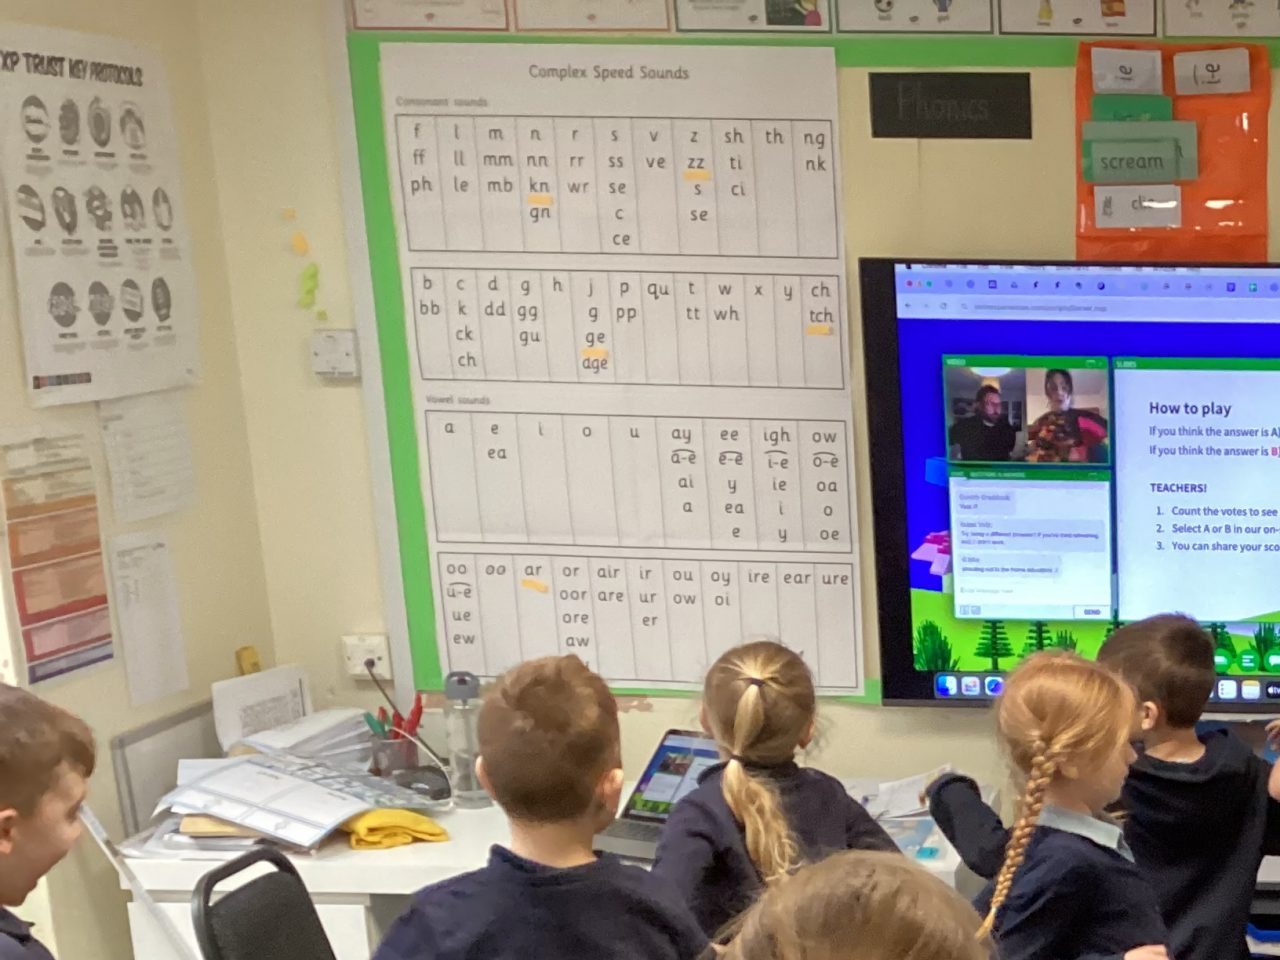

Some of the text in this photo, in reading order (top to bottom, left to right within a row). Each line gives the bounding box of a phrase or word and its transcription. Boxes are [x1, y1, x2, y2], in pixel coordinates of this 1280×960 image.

[22, 52, 65, 77] TRUST
[69, 58, 88, 80] KEY
[90, 61, 143, 87] PROTOCOLS
[529, 64, 690, 82] Complex Speed Sounds
[413, 149, 826, 171] ff ll mm nn rr ss ve zz ti nk
[1101, 156, 1164, 169] scream
[420, 300, 834, 323] bb k dd gg g pp tt wh tch
[1150, 402, 1231, 418] How to play
[445, 423, 455, 434] a
[491, 424, 499, 435] e
[582, 426, 592, 437] o
[630, 428, 640, 438] u
[671, 429, 691, 444] ay
[720, 430, 739, 441] ee
[764, 426, 791, 446] igh
[812, 432, 837, 443] ow
[1149, 426, 1156, 436] If
[1157, 428, 1176, 438] you
[1178, 426, 1204, 436] think
[1205, 426, 1222, 436] the
[1224, 429, 1259, 437] answer
[1261, 428, 1269, 437] is
[1271, 427, 1280, 438] A)
[1149, 445, 1156, 454] If
[1158, 448, 1176, 457] you
[1178, 445, 1204, 455] think
[1205, 446, 1222, 456] the
[1224, 448, 1259, 456] answer
[1261, 446, 1269, 456] is
[1150, 483, 1207, 493] TEACHERS!
[1157, 506, 1164, 515] 1.
[1171, 506, 1201, 516] Count
[1203, 506, 1219, 516] the
[1220, 507, 1247, 516] votes
[1249, 508, 1260, 516] to
[1261, 509, 1278, 517] see
[1156, 524, 1164, 533] 2.
[1172, 523, 1201, 533] Select
[1203, 524, 1210, 533] A
[1212, 526, 1223, 534] or
[1225, 524, 1231, 534] B
[1233, 524, 1243, 534] in
[1244, 526, 1261, 534] our
[1157, 541, 1164, 550] 3.
[1172, 541, 1190, 551] You
[1192, 543, 1209, 551] can
[1211, 541, 1238, 551] share
[1240, 544, 1262, 553] your
[446, 564, 849, 587] oo oo ar or air ir ou oy ire ear ure
